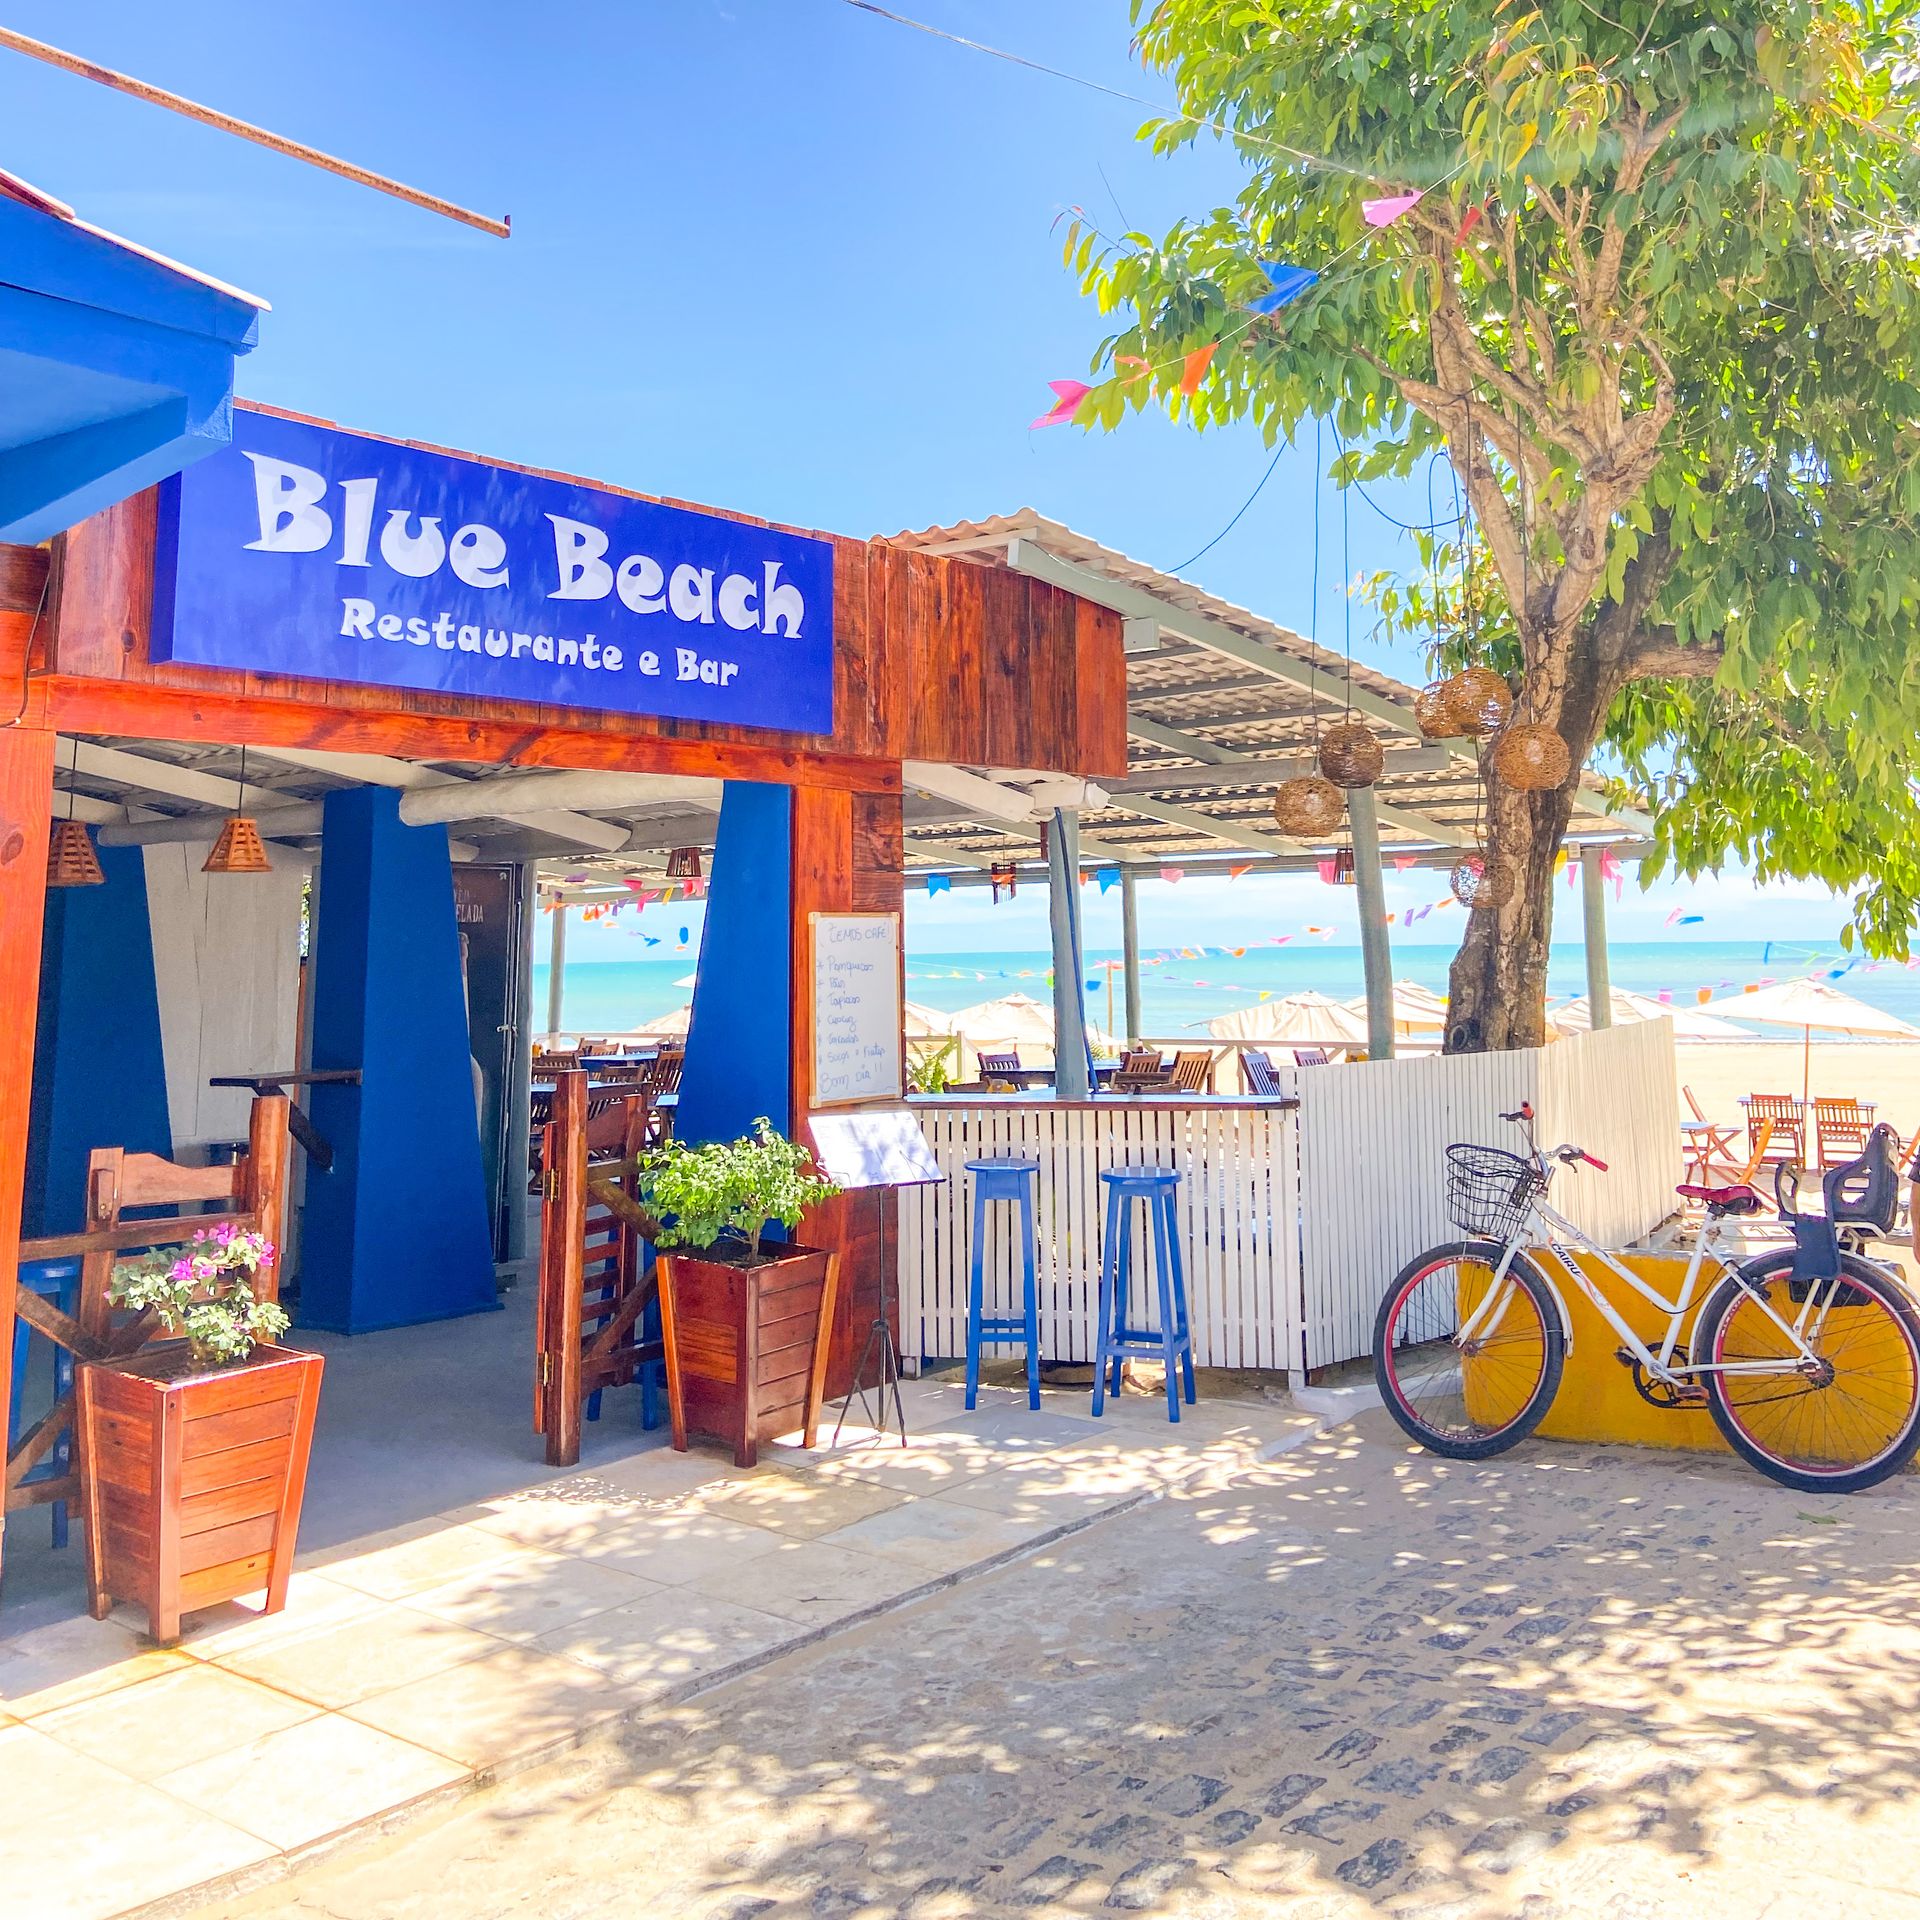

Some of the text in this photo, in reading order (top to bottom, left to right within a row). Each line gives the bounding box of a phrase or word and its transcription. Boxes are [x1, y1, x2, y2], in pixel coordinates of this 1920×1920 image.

[241, 450, 805, 639] Blue Beach
[339, 598, 739, 686] Restaurante e Bar
[456, 904, 484, 923] ELADA
[1551, 1242, 1582, 1276] CAIRU
